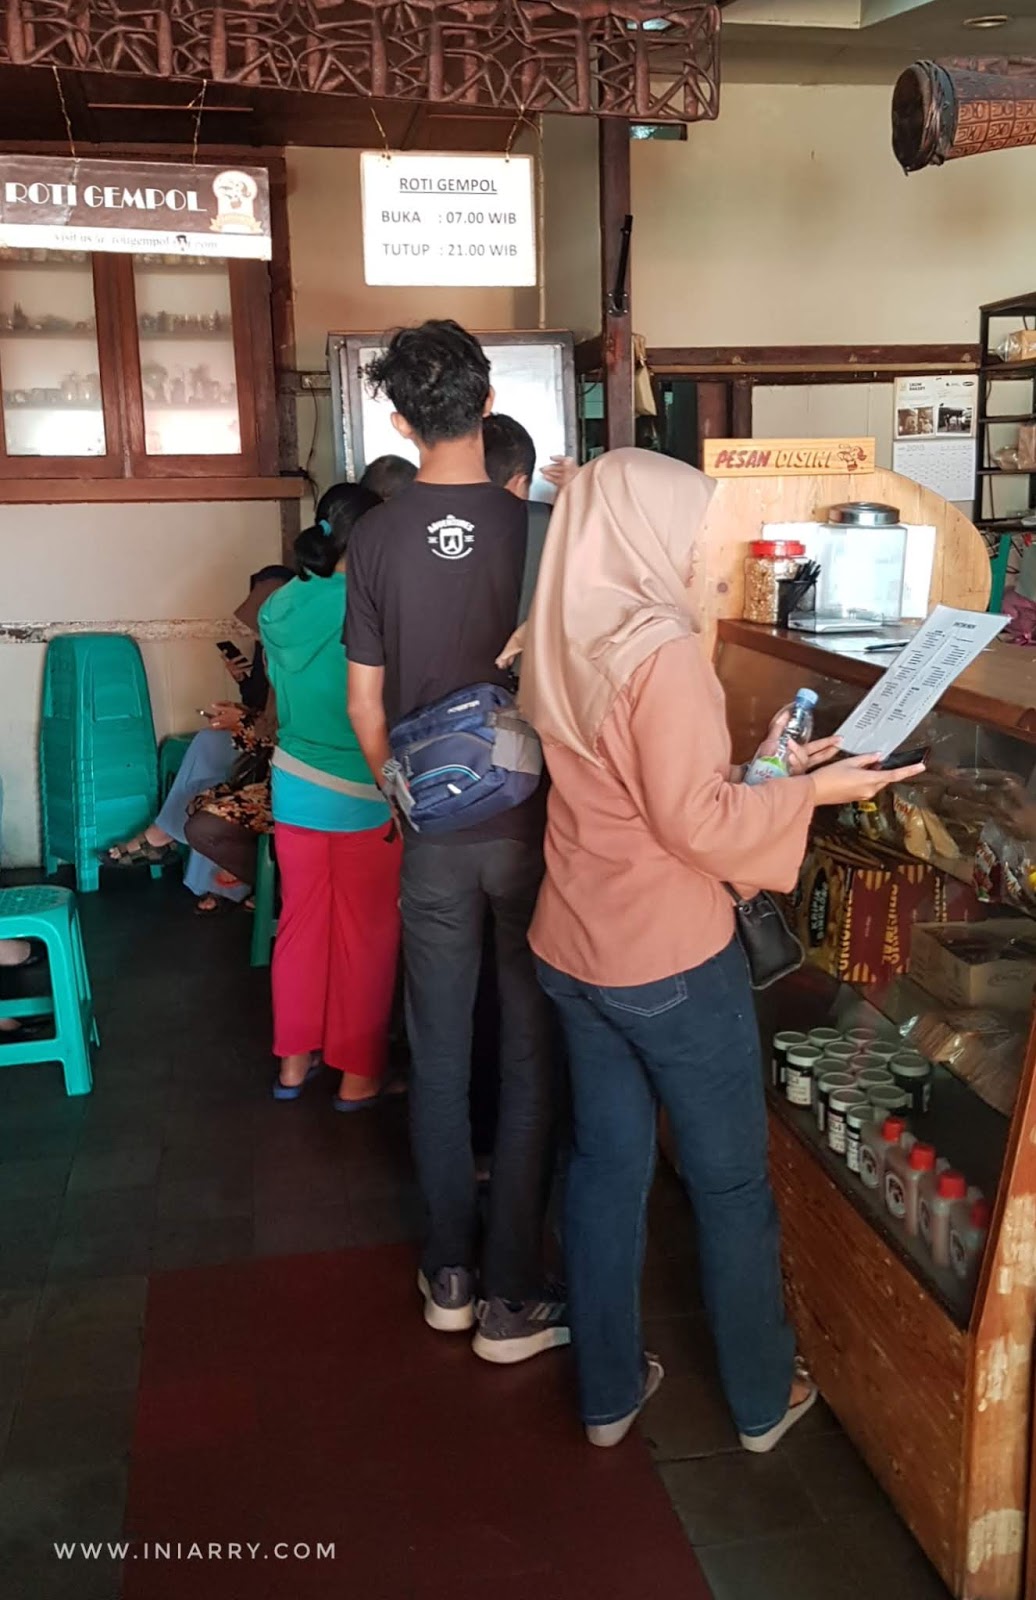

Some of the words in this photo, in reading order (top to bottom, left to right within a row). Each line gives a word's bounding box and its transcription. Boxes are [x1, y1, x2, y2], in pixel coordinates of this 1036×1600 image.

[399, 178, 433, 191] ROTI
[437, 179, 497, 192] GEMPOL
[5, 181, 77, 206] ROTI
[84, 185, 207, 212] GEMPOL
[381, 210, 421, 223] BUKA
[446, 212, 484, 224] 07.00
[488, 212, 517, 224] WIB
[382, 243, 430, 256] TUTUP
[448, 244, 485, 256] 21.00
[489, 244, 518, 256] WIB
[714, 450, 772, 468] PESAN
